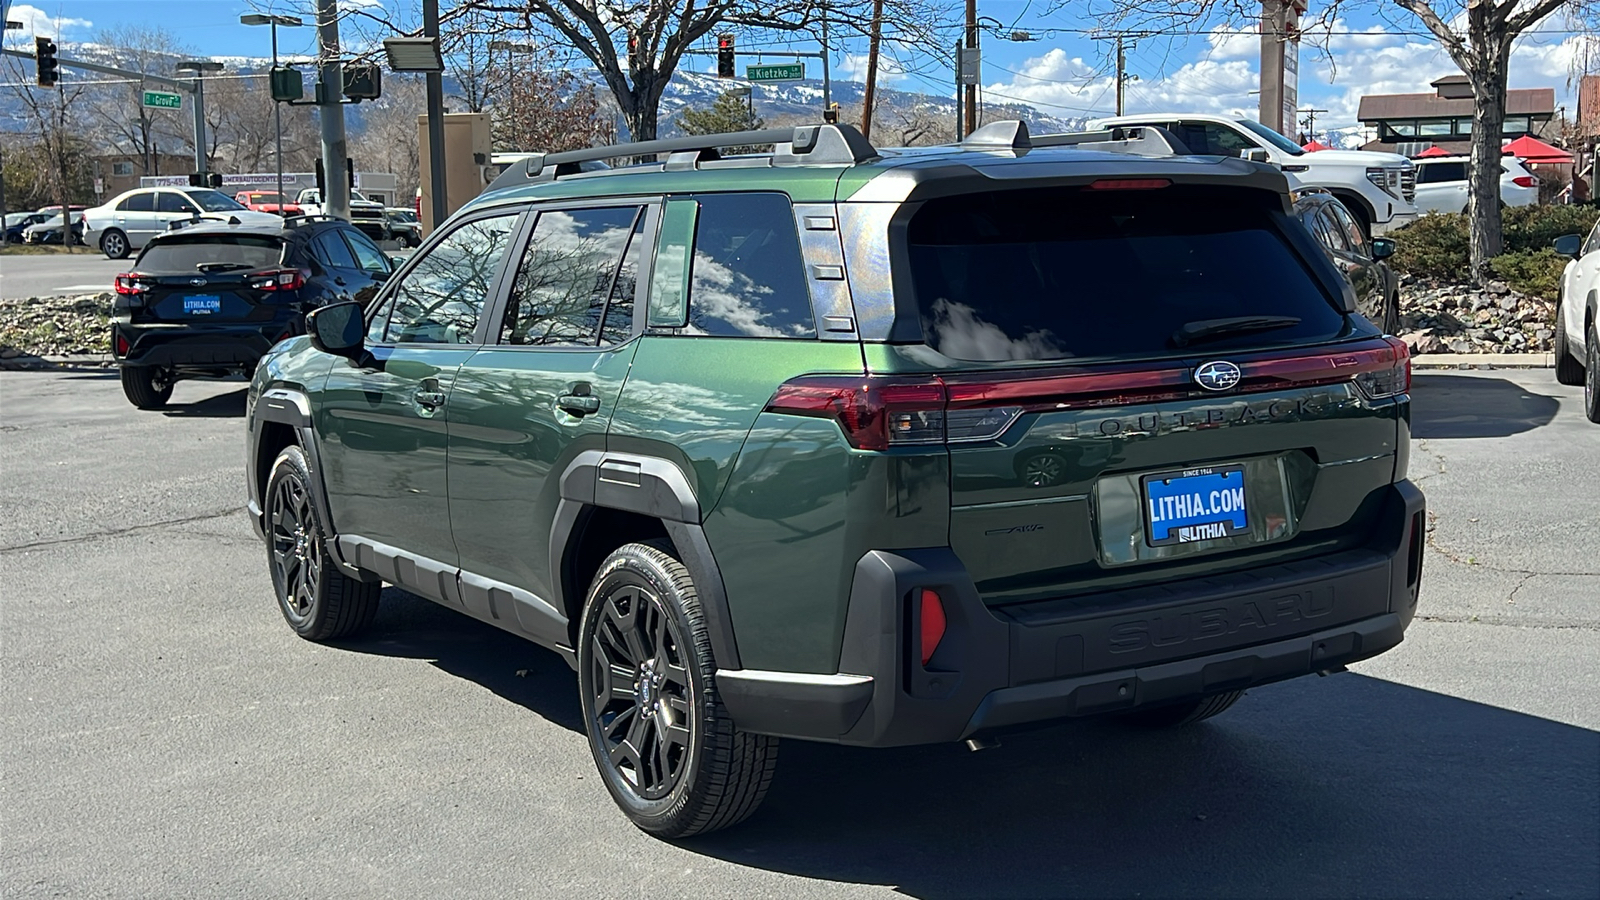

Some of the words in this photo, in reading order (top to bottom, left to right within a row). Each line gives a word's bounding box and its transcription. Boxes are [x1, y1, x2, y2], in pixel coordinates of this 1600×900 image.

[756, 68, 788, 78] Kietzke
[155, 95, 173, 106] Grove
[157, 178, 189, 186] 775-451-
[184, 301, 220, 309] LITHIA.COM
[1100, 400, 1314, 436] OUTBACK
[1183, 469, 1199, 477] SINCE
[1149, 487, 1245, 522] LITHIA.COM
[1189, 522, 1227, 541] LITHIA
[1108, 586, 1335, 654] SUBARU
